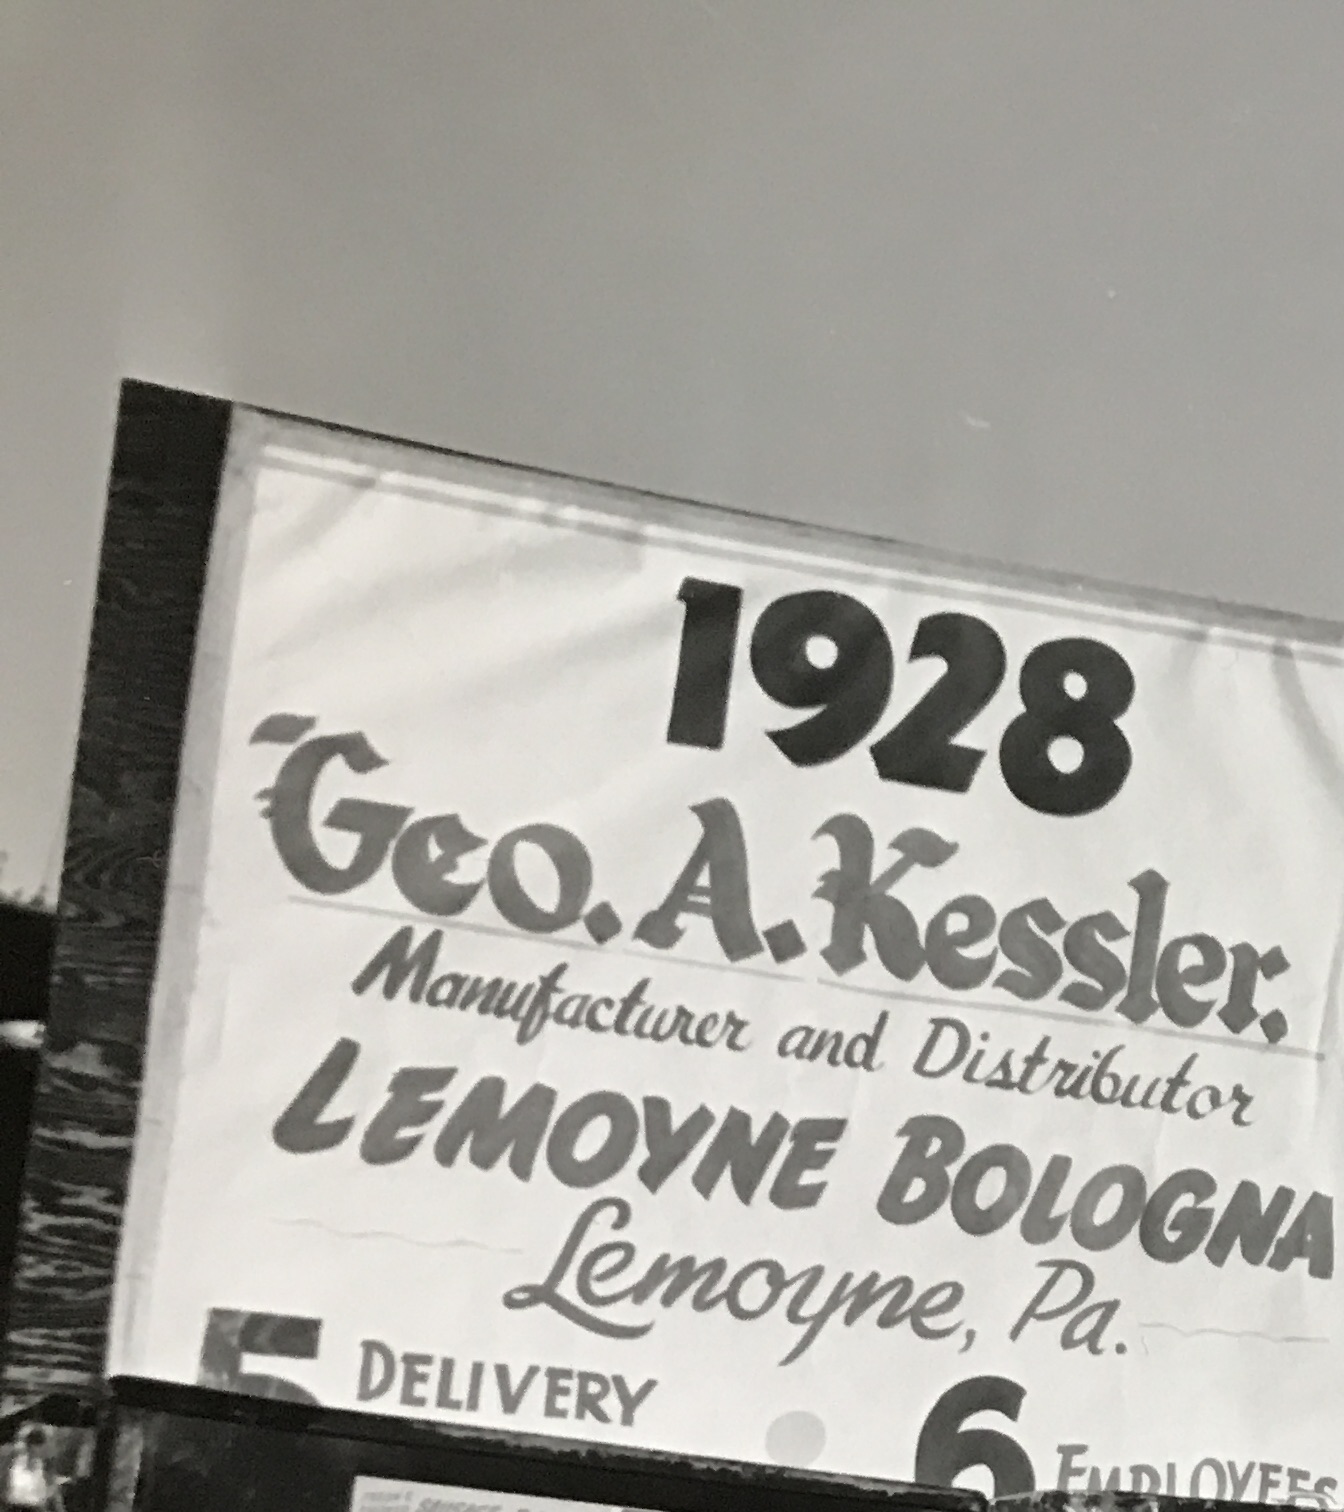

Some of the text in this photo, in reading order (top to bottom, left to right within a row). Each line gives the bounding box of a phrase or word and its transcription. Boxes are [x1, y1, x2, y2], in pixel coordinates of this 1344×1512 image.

[666, 576, 1136, 817] 1928
[250, 713, 622, 946] Geo.
[633, 798, 807, 965] A.
[352, 926, 1254, 1126] Manufacturer and Distributor
[273, 1037, 1334, 1279] LEMOYNE BOLOGNA
[198, 1307, 659, 1426] 5 DELIVERY
[503, 1196, 1127, 1366] Lemoyne, Pa.
[914, 1375, 1037, 1499] 6
